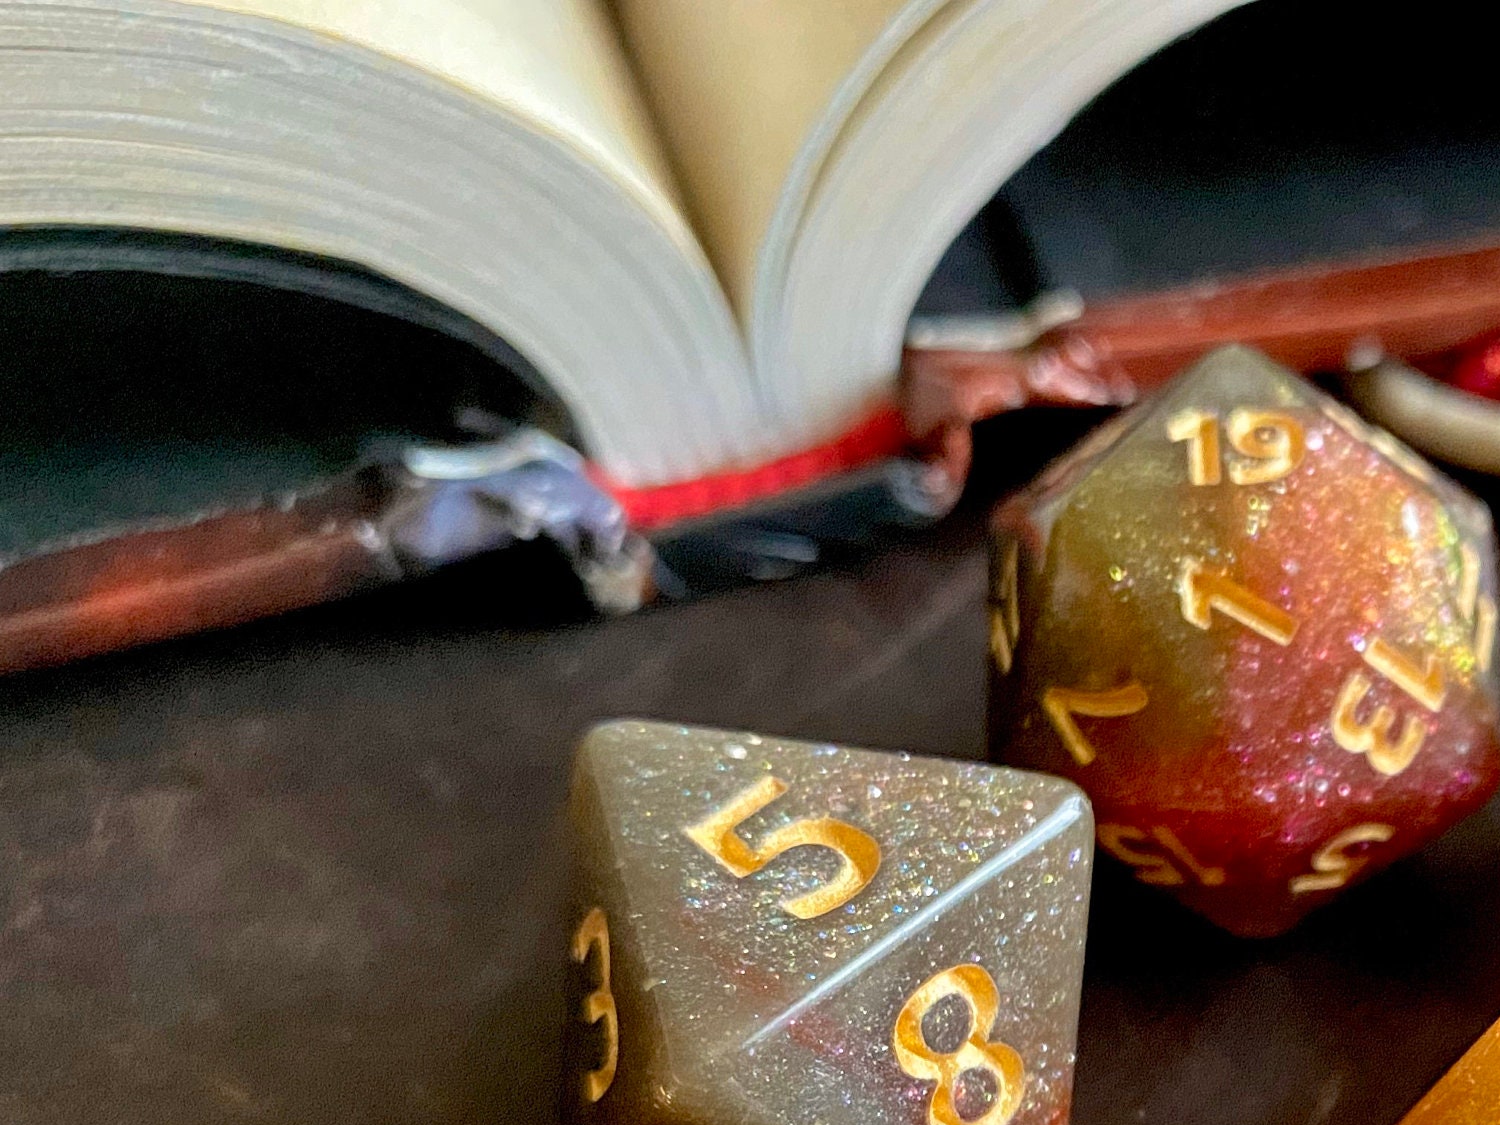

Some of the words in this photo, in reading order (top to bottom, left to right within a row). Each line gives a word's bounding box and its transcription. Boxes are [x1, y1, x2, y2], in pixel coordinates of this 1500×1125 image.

[1167, 407, 1304, 486] 19
[1180, 556, 1302, 646] 1
[1042, 682, 1149, 765] 7
[1331, 636, 1447, 776] 13
[683, 774, 882, 920] 5
[572, 908, 619, 1103] 3
